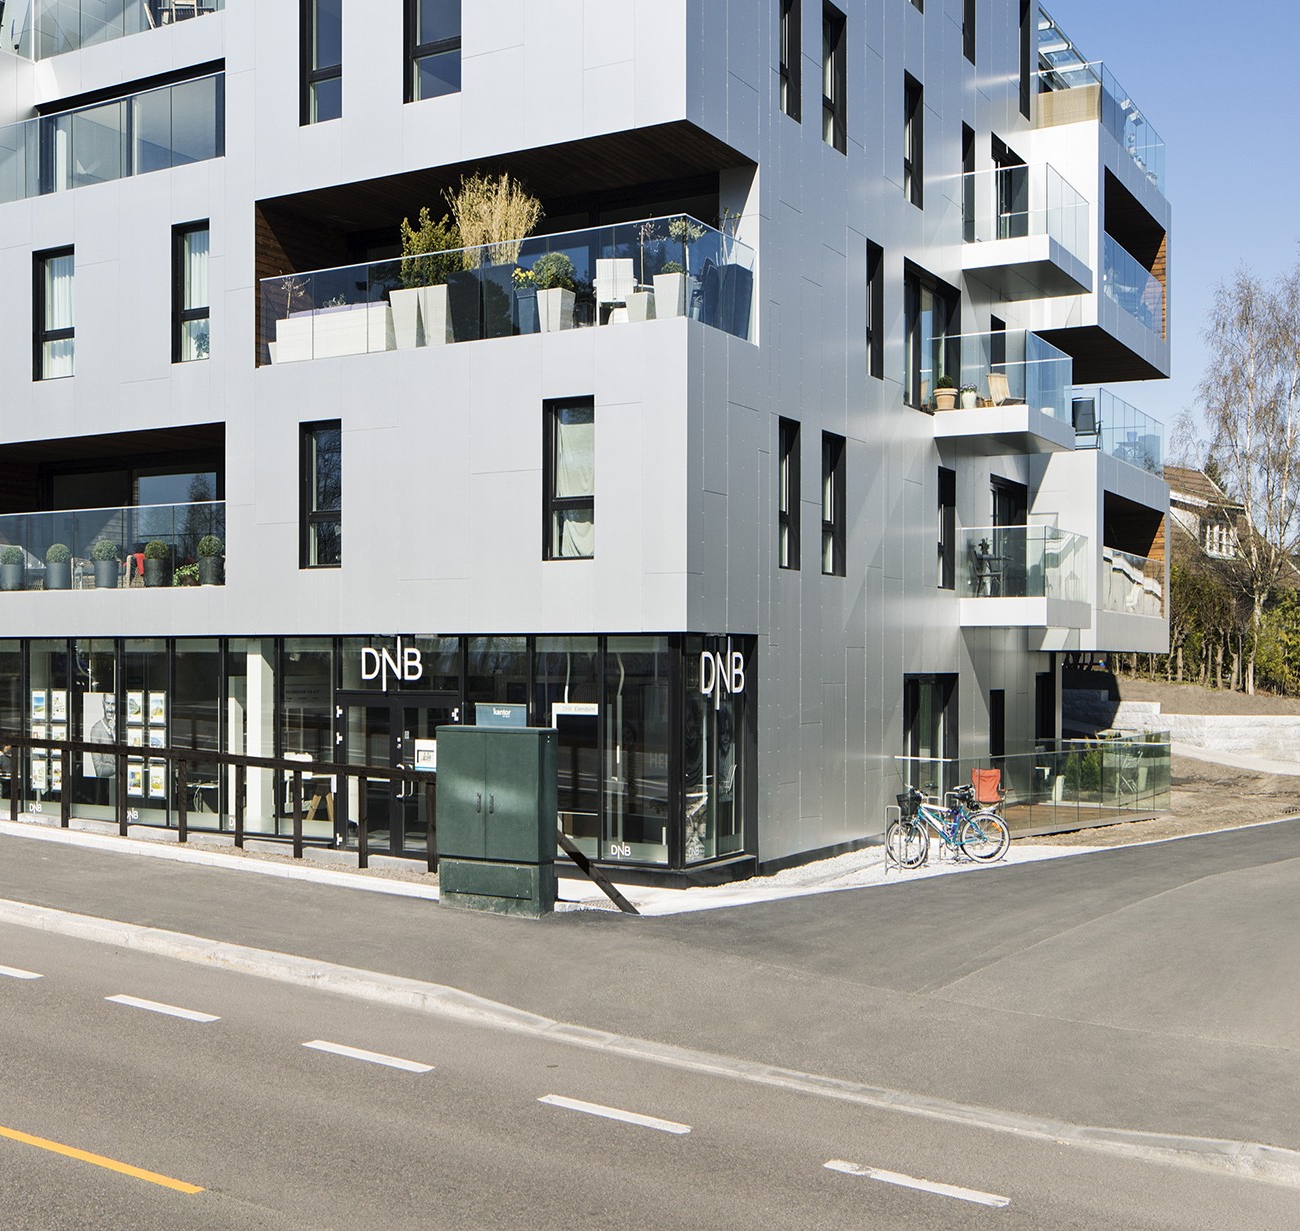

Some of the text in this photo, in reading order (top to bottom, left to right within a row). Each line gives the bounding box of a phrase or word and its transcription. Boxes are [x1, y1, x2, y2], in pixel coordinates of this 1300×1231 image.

[361, 636, 423, 692] DNB
[700, 636, 745, 710] DNB
[29, 801, 42, 815] DNB
[611, 842, 631, 859] DNB
